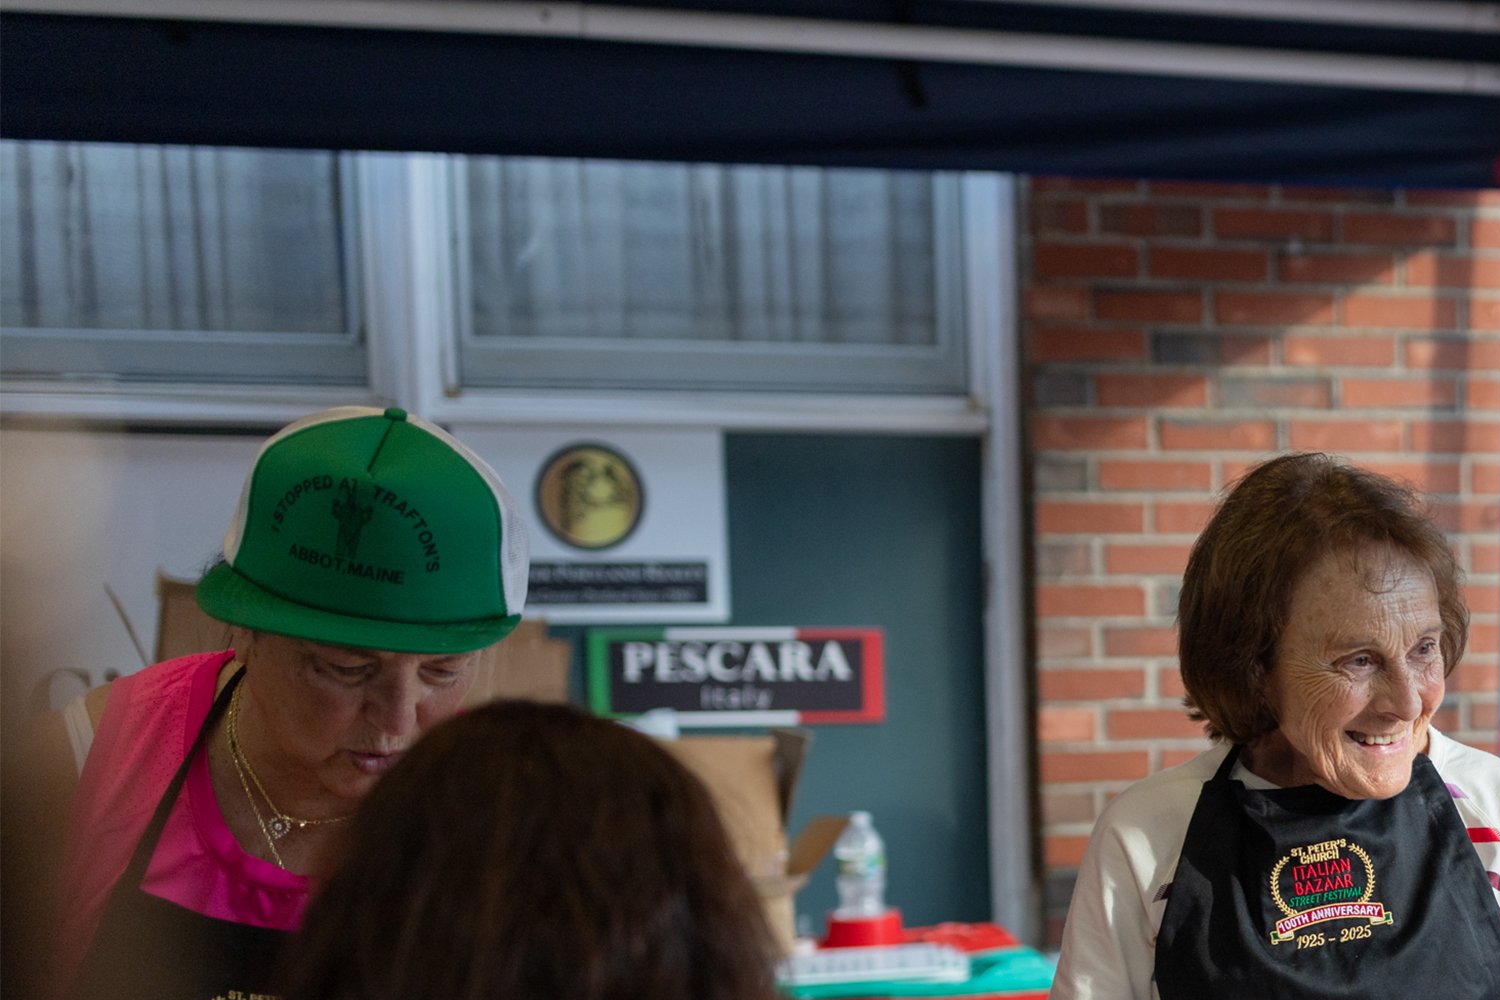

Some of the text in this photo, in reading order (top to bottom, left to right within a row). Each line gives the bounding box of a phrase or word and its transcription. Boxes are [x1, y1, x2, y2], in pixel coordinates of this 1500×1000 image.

[273, 474, 333, 525] STOPPED
[271, 525, 280, 533] I
[373, 484, 440, 573] TRAFTON'S
[622, 640, 853, 683] PESCARA
[1291, 839, 1346, 856] ST. PETER'S
[1301, 849, 1339, 863] CHURCH
[1293, 858, 1351, 880] ITALIAN
[1296, 874, 1353, 896] BAZAAR
[1289, 887, 1362, 907] STREET FESTIVAL
[1279, 906, 1380, 931] 100TH ANNIVERSARY
[1297, 933, 1325, 948] 1925
[1341, 925, 1371, 942] 2025
